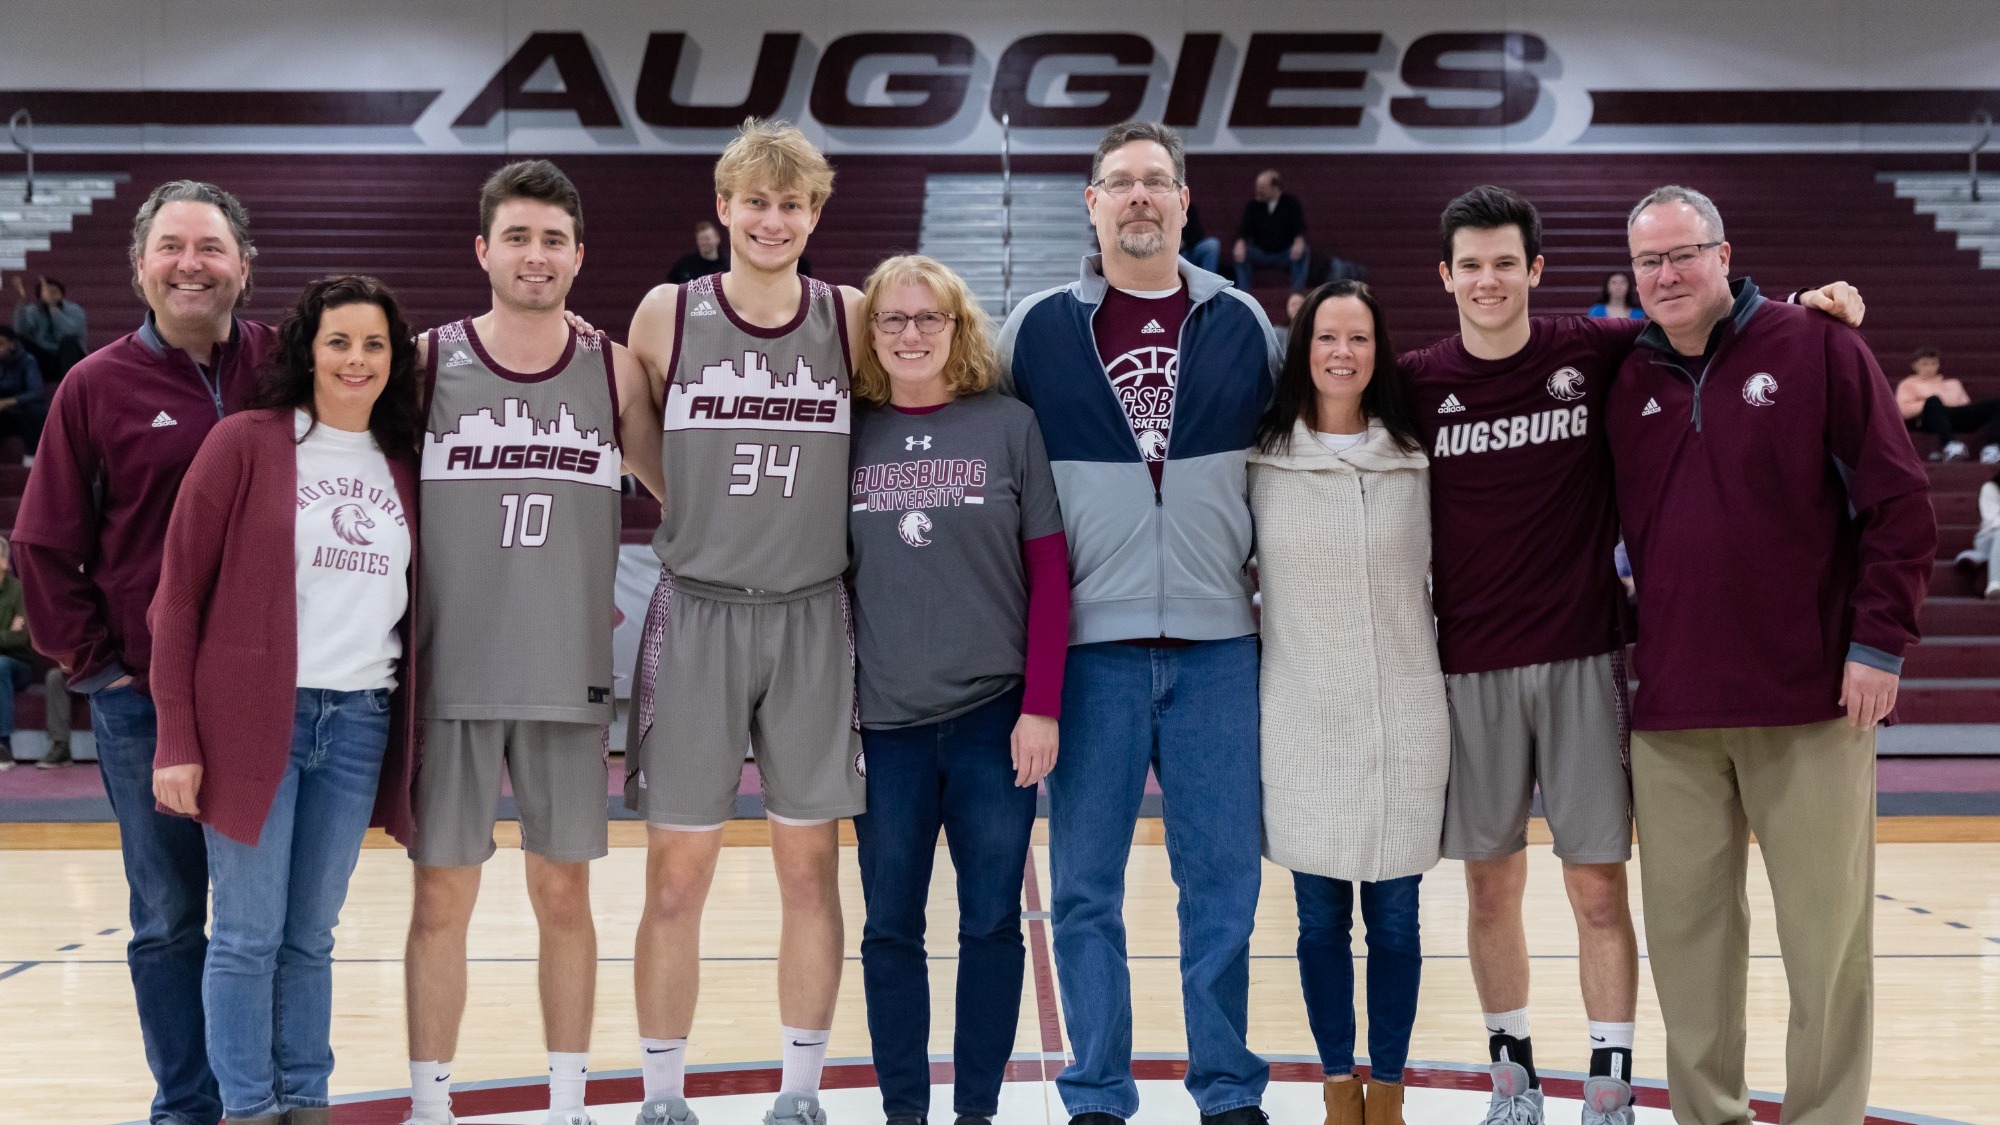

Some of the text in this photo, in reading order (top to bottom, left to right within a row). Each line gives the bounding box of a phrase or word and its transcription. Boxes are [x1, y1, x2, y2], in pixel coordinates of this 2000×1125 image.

[450, 31, 1549, 129] AUGGIES
[690, 308, 717, 317] adidas
[446, 358, 473, 368] adidas
[688, 395, 838, 424] AUGGIES
[1114, 386, 1175, 418] GSB
[1437, 404, 1466, 414] adidas
[1433, 404, 1589, 458] AUGSBURG
[447, 444, 601, 475] AUGGIES
[728, 442, 800, 498] 34
[852, 459, 987, 496] AUGSBURG
[868, 487, 964, 512] UNIVERSITY
[501, 493, 554, 548] 10
[311, 545, 390, 576] AUGGIES
